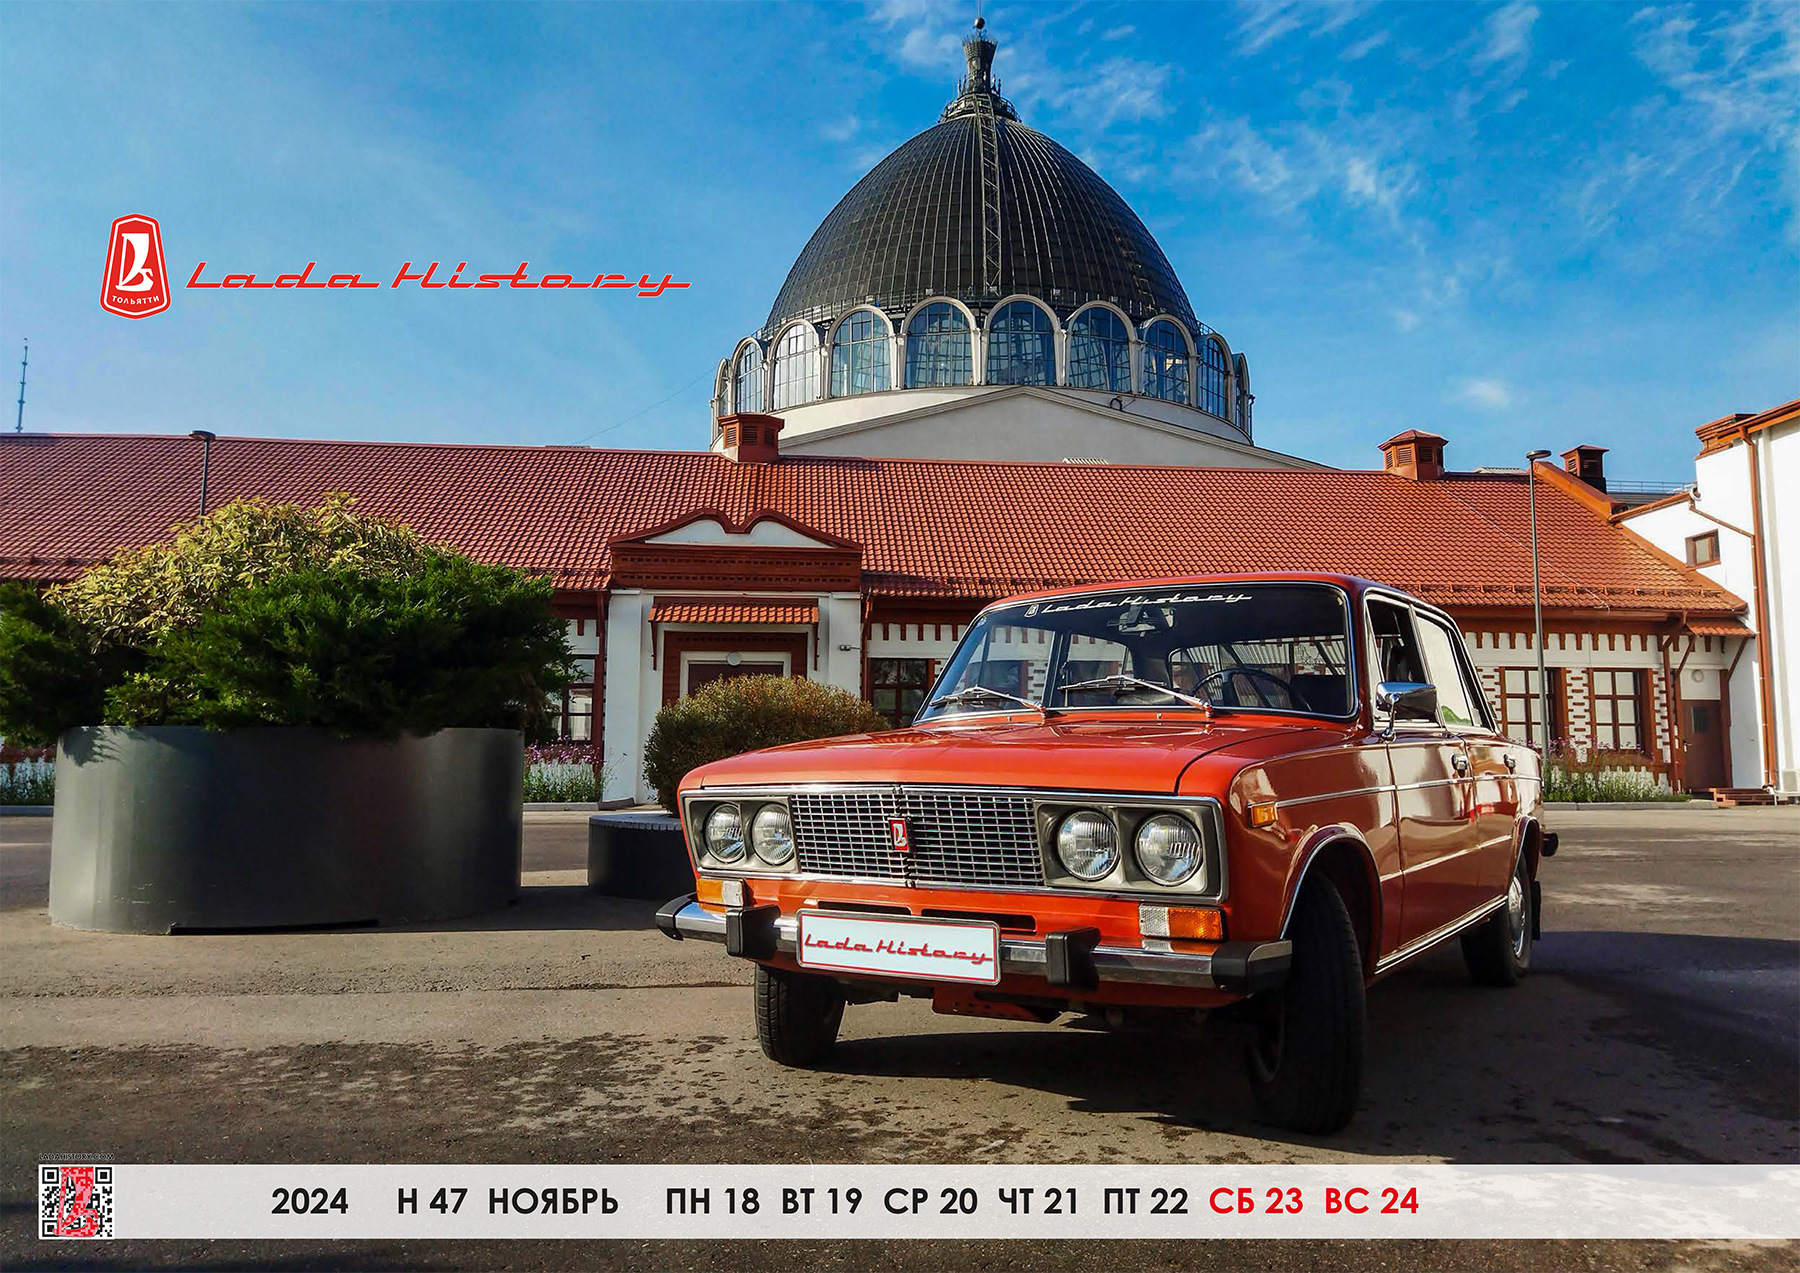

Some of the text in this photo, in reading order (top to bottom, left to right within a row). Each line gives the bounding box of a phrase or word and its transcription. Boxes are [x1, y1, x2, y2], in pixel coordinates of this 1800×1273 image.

[1041, 592, 1253, 614] Lada History
[804, 934, 993, 965] Lada History
